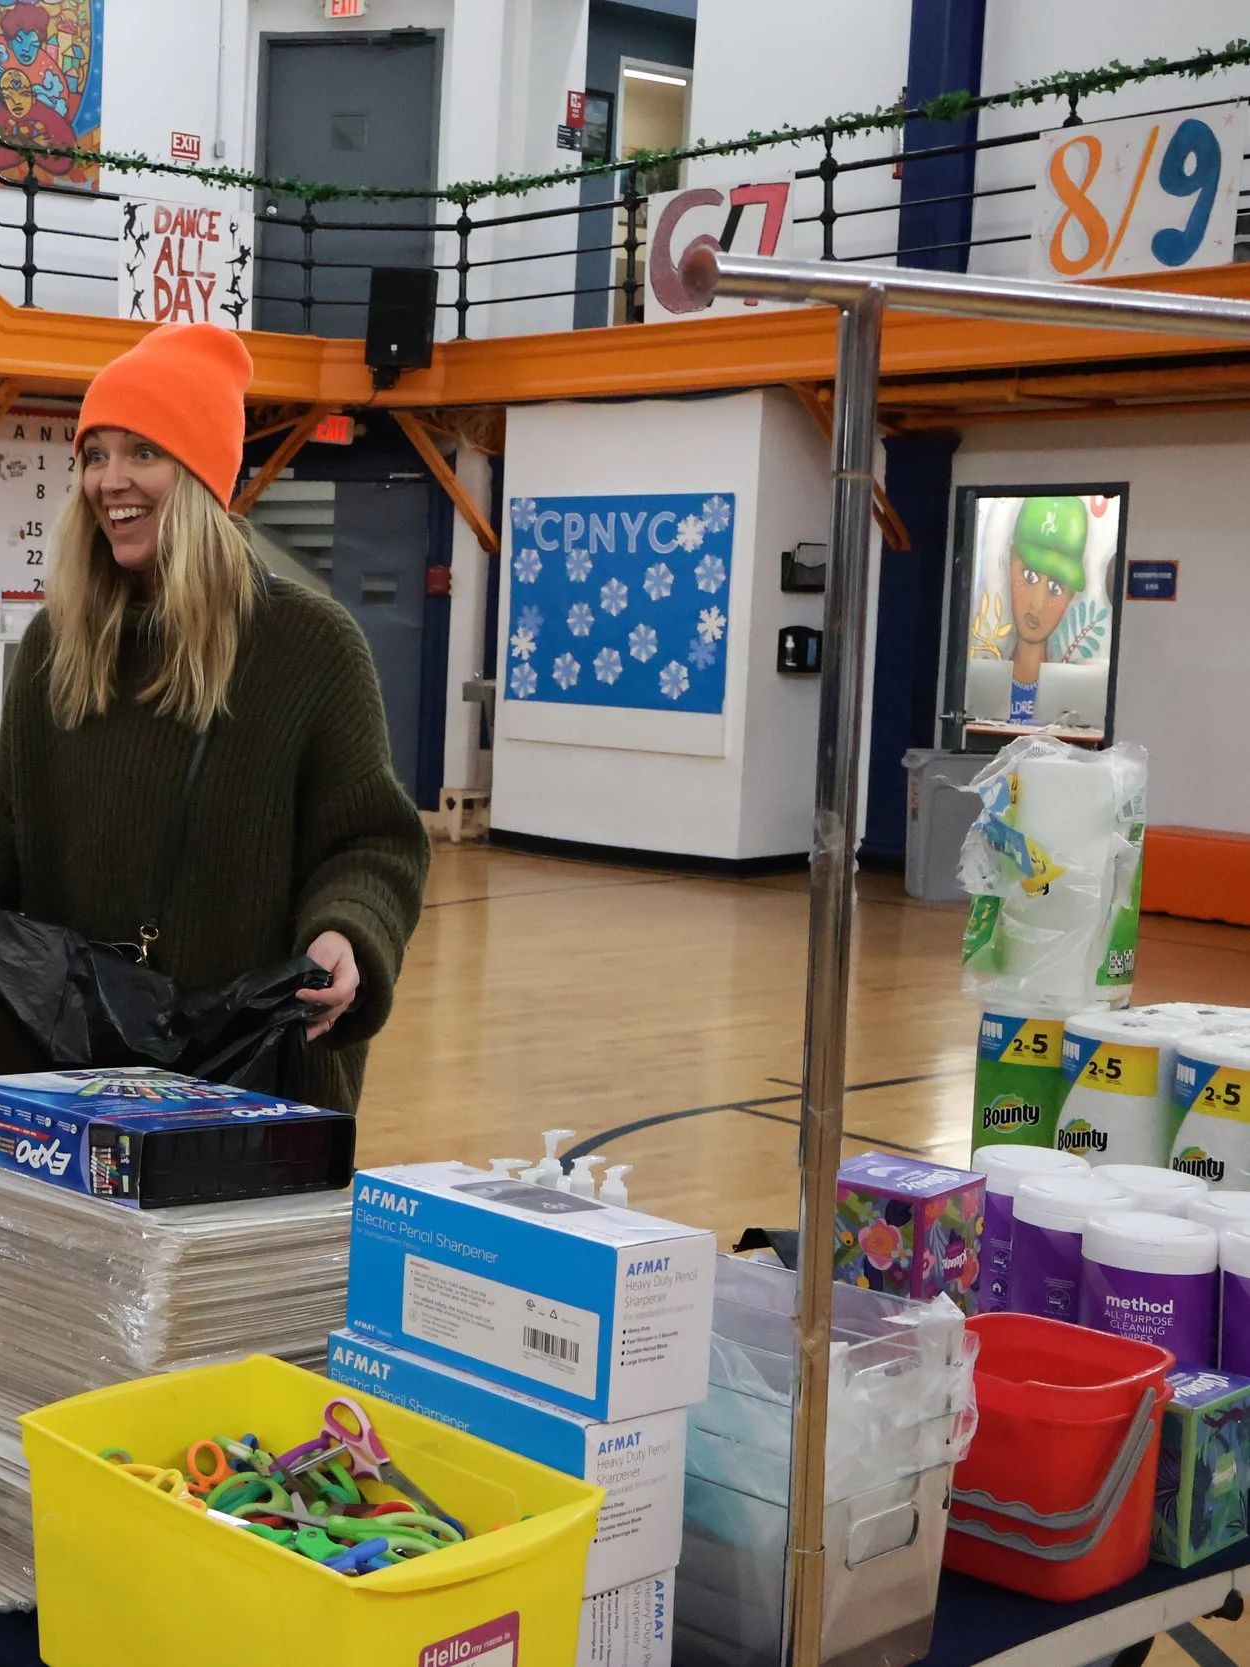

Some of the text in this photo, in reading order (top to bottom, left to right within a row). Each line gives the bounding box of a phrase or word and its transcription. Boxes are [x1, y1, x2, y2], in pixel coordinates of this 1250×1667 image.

[172, 133, 200, 152] EXIT
[1050, 118, 1221, 275] 8/9
[154, 205, 221, 241] DANCE
[153, 236, 216, 278] ALL
[154, 276, 216, 323] DAY
[38, 455, 45, 470] 1
[36, 484, 45, 499] 8
[26, 521, 43, 537] 15
[533, 511, 679, 553] CPNYC
[26, 550, 43, 565] 22
[982, 1103, 1040, 1130] Bounty
[1057, 1129, 1108, 1152] Bounty
[16, 1137, 72, 1176] EXPO
[357, 1185, 419, 1217] AFMAT
[356, 1208, 397, 1233] Electric
[400, 1221, 433, 1245] Pencil
[436, 1232, 498, 1264] Sharpener
[627, 1257, 670, 1277] AFMAT
[625, 1280, 651, 1292] Heavy
[1106, 1294, 1174, 1315] method
[354, 1319, 375, 1331] AFMAT
[1104, 1309, 1174, 1327] ALL-PURPOSE
[1110, 1319, 1165, 1336] CLEANING
[333, 1346, 391, 1381] AFMAT
[331, 1367, 370, 1394] Electric
[598, 1432, 641, 1456] AFMAT
[597, 1457, 624, 1470] Heavy
[627, 1450, 646, 1463] Duty
[597, 1467, 640, 1486] Sharpener
[654, 1580, 664, 1641] AFMAT
[424, 1640, 471, 1667] Hello
[471, 1643, 483, 1654] my
[484, 1637, 503, 1648] name
